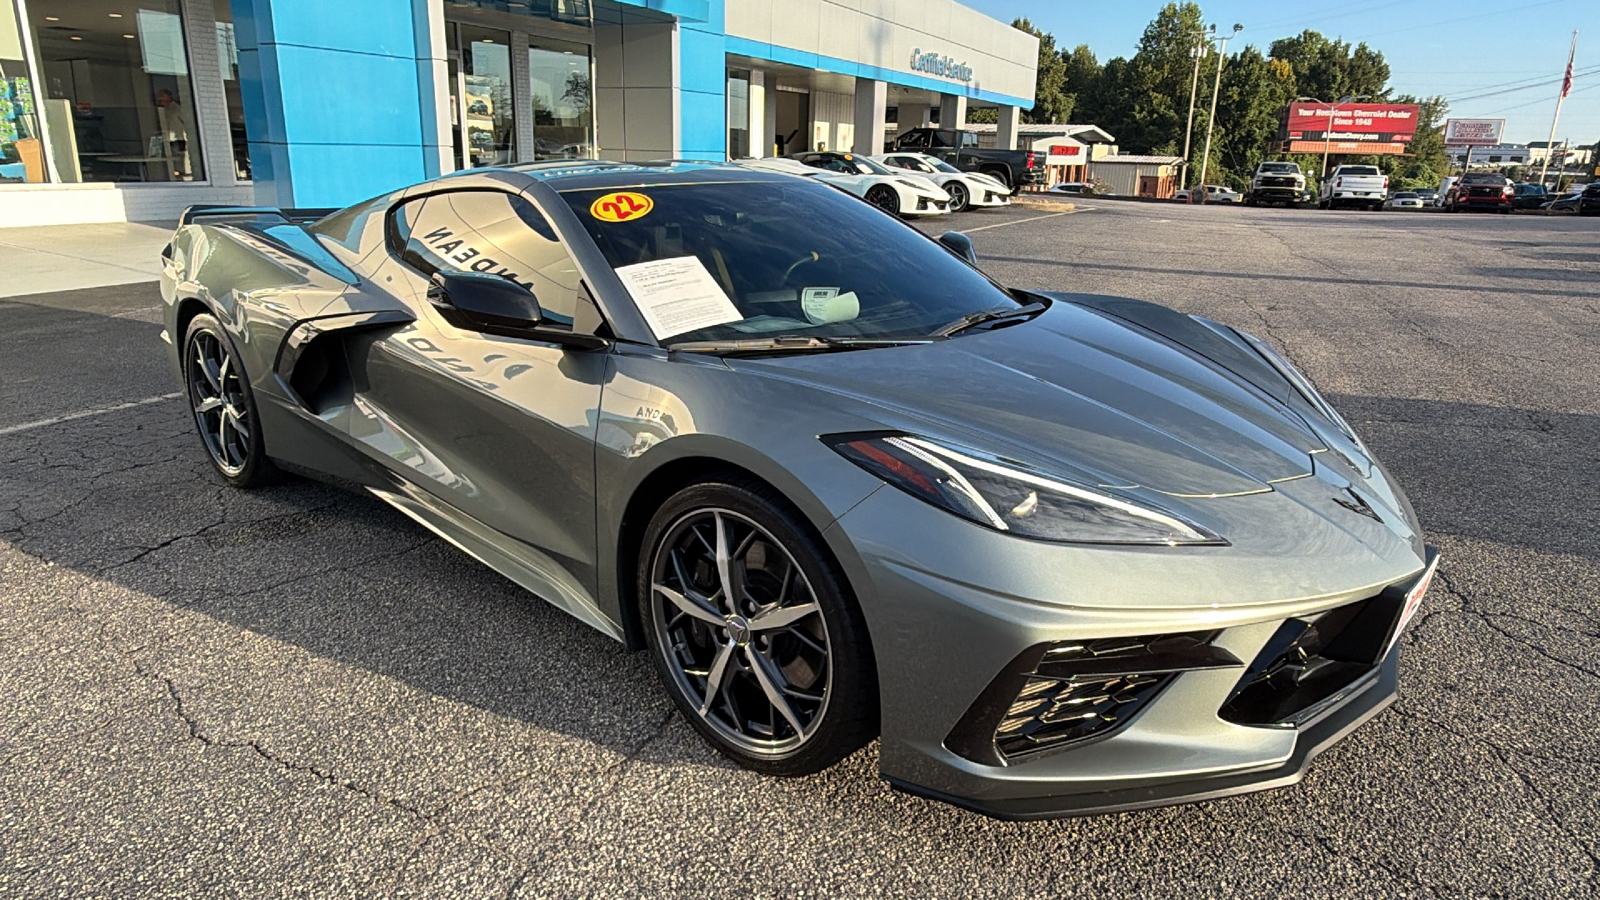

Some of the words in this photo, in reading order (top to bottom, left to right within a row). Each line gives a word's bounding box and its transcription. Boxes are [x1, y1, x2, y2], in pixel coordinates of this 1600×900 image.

[910, 47, 947, 76] Certified
[945, 57, 973, 82] Service
[1298, 108, 1315, 117] Your
[1353, 109, 1387, 118] Chevrolet
[1387, 110, 1411, 119] Dealer
[1333, 117, 1354, 126] Since
[602, 195, 646, 219] 22
